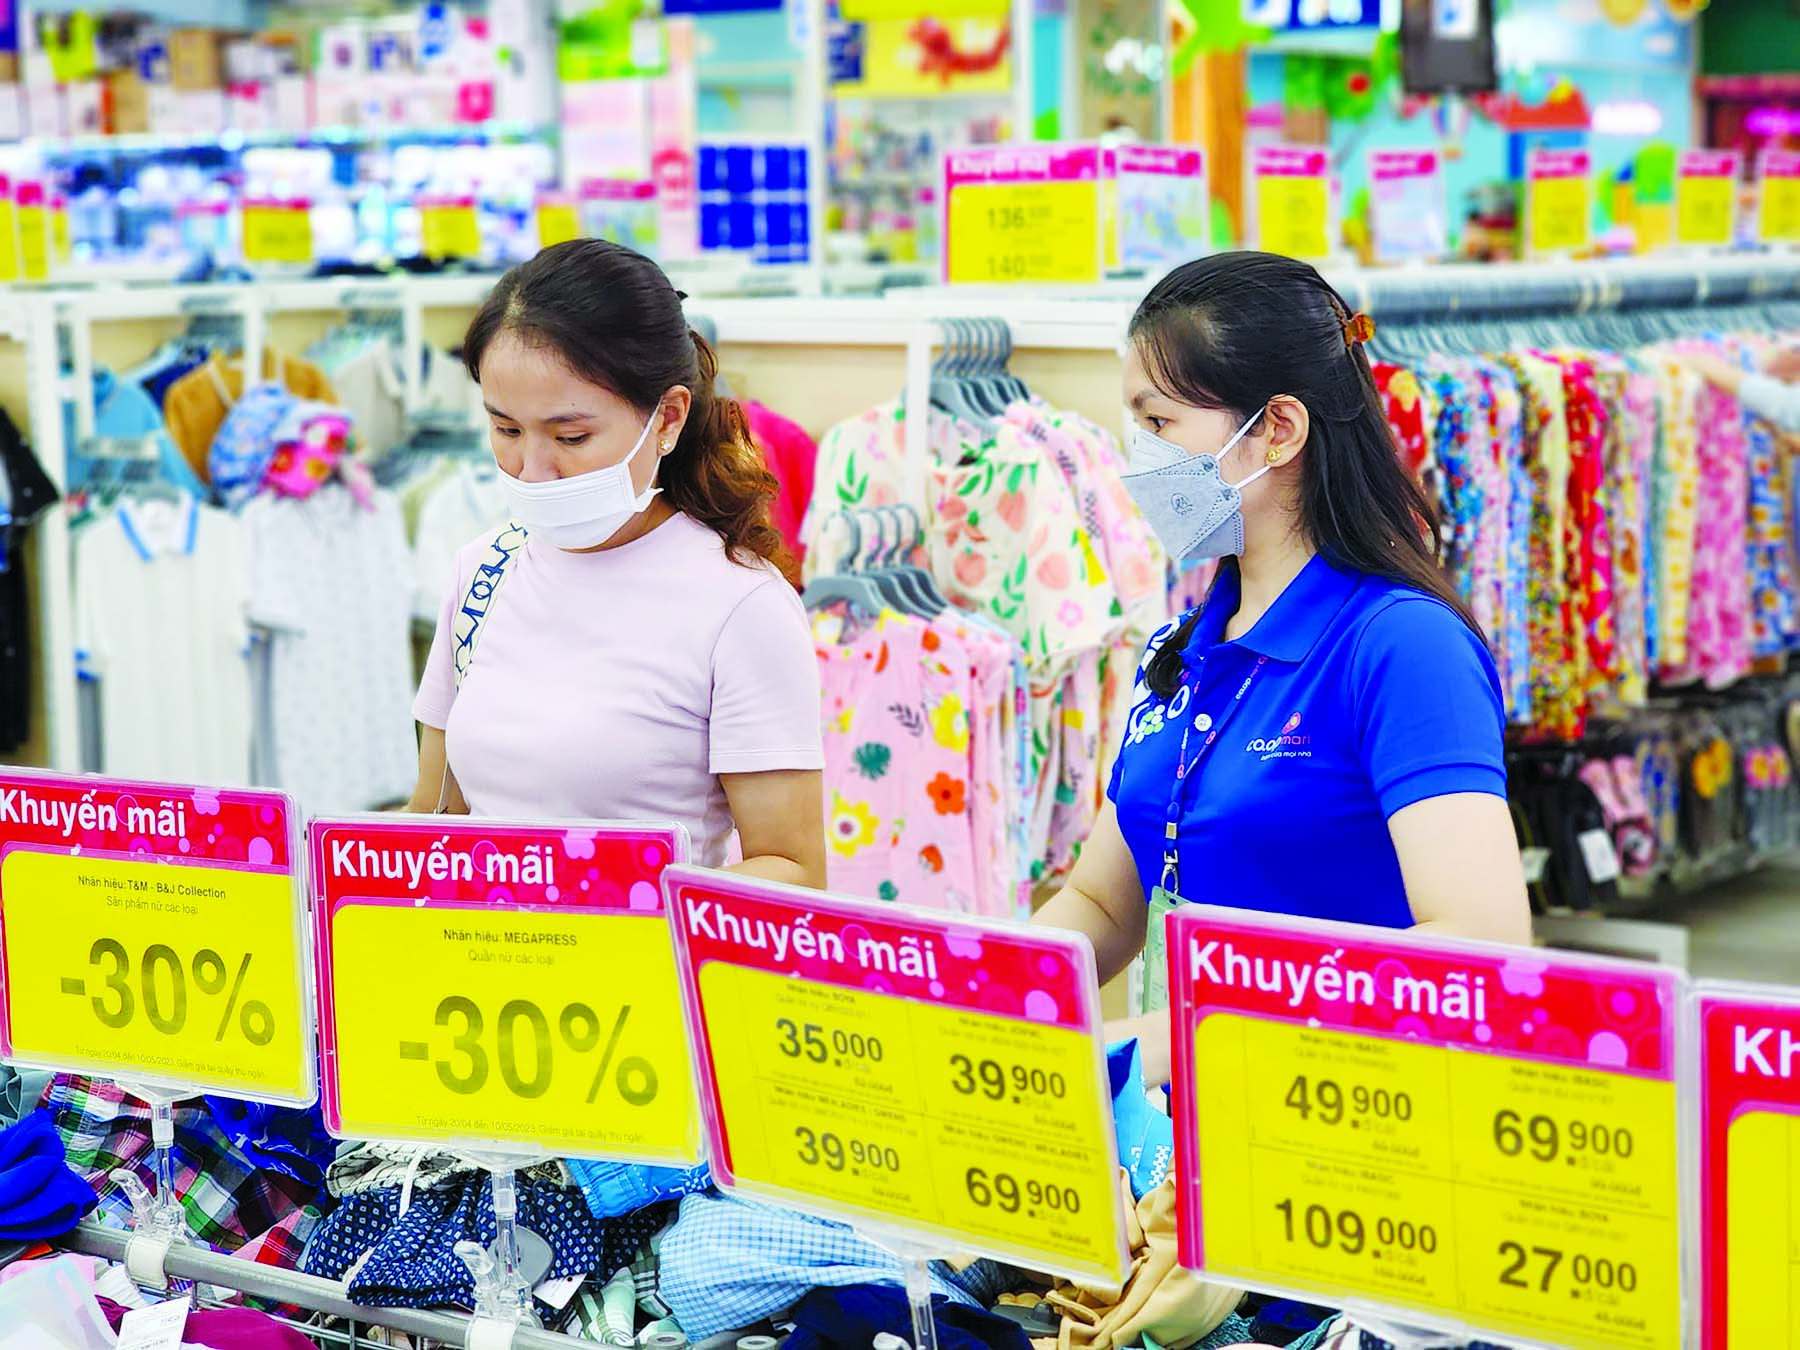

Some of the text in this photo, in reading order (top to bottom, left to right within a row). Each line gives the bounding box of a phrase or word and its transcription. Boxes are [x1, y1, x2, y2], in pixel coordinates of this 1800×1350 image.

[0, 788, 186, 837] Khuyến mãi
[177, 884, 226, 899] Collection
[332, 836, 554, 889] Khuyến mãi
[504, 932, 577, 946] MEGAPRESS
[685, 898, 938, 980] Khuyến mãi
[60, 938, 275, 1046] -30%
[1190, 938, 1486, 1022] Khuyến mãi
[400, 996, 658, 1106] -30%
